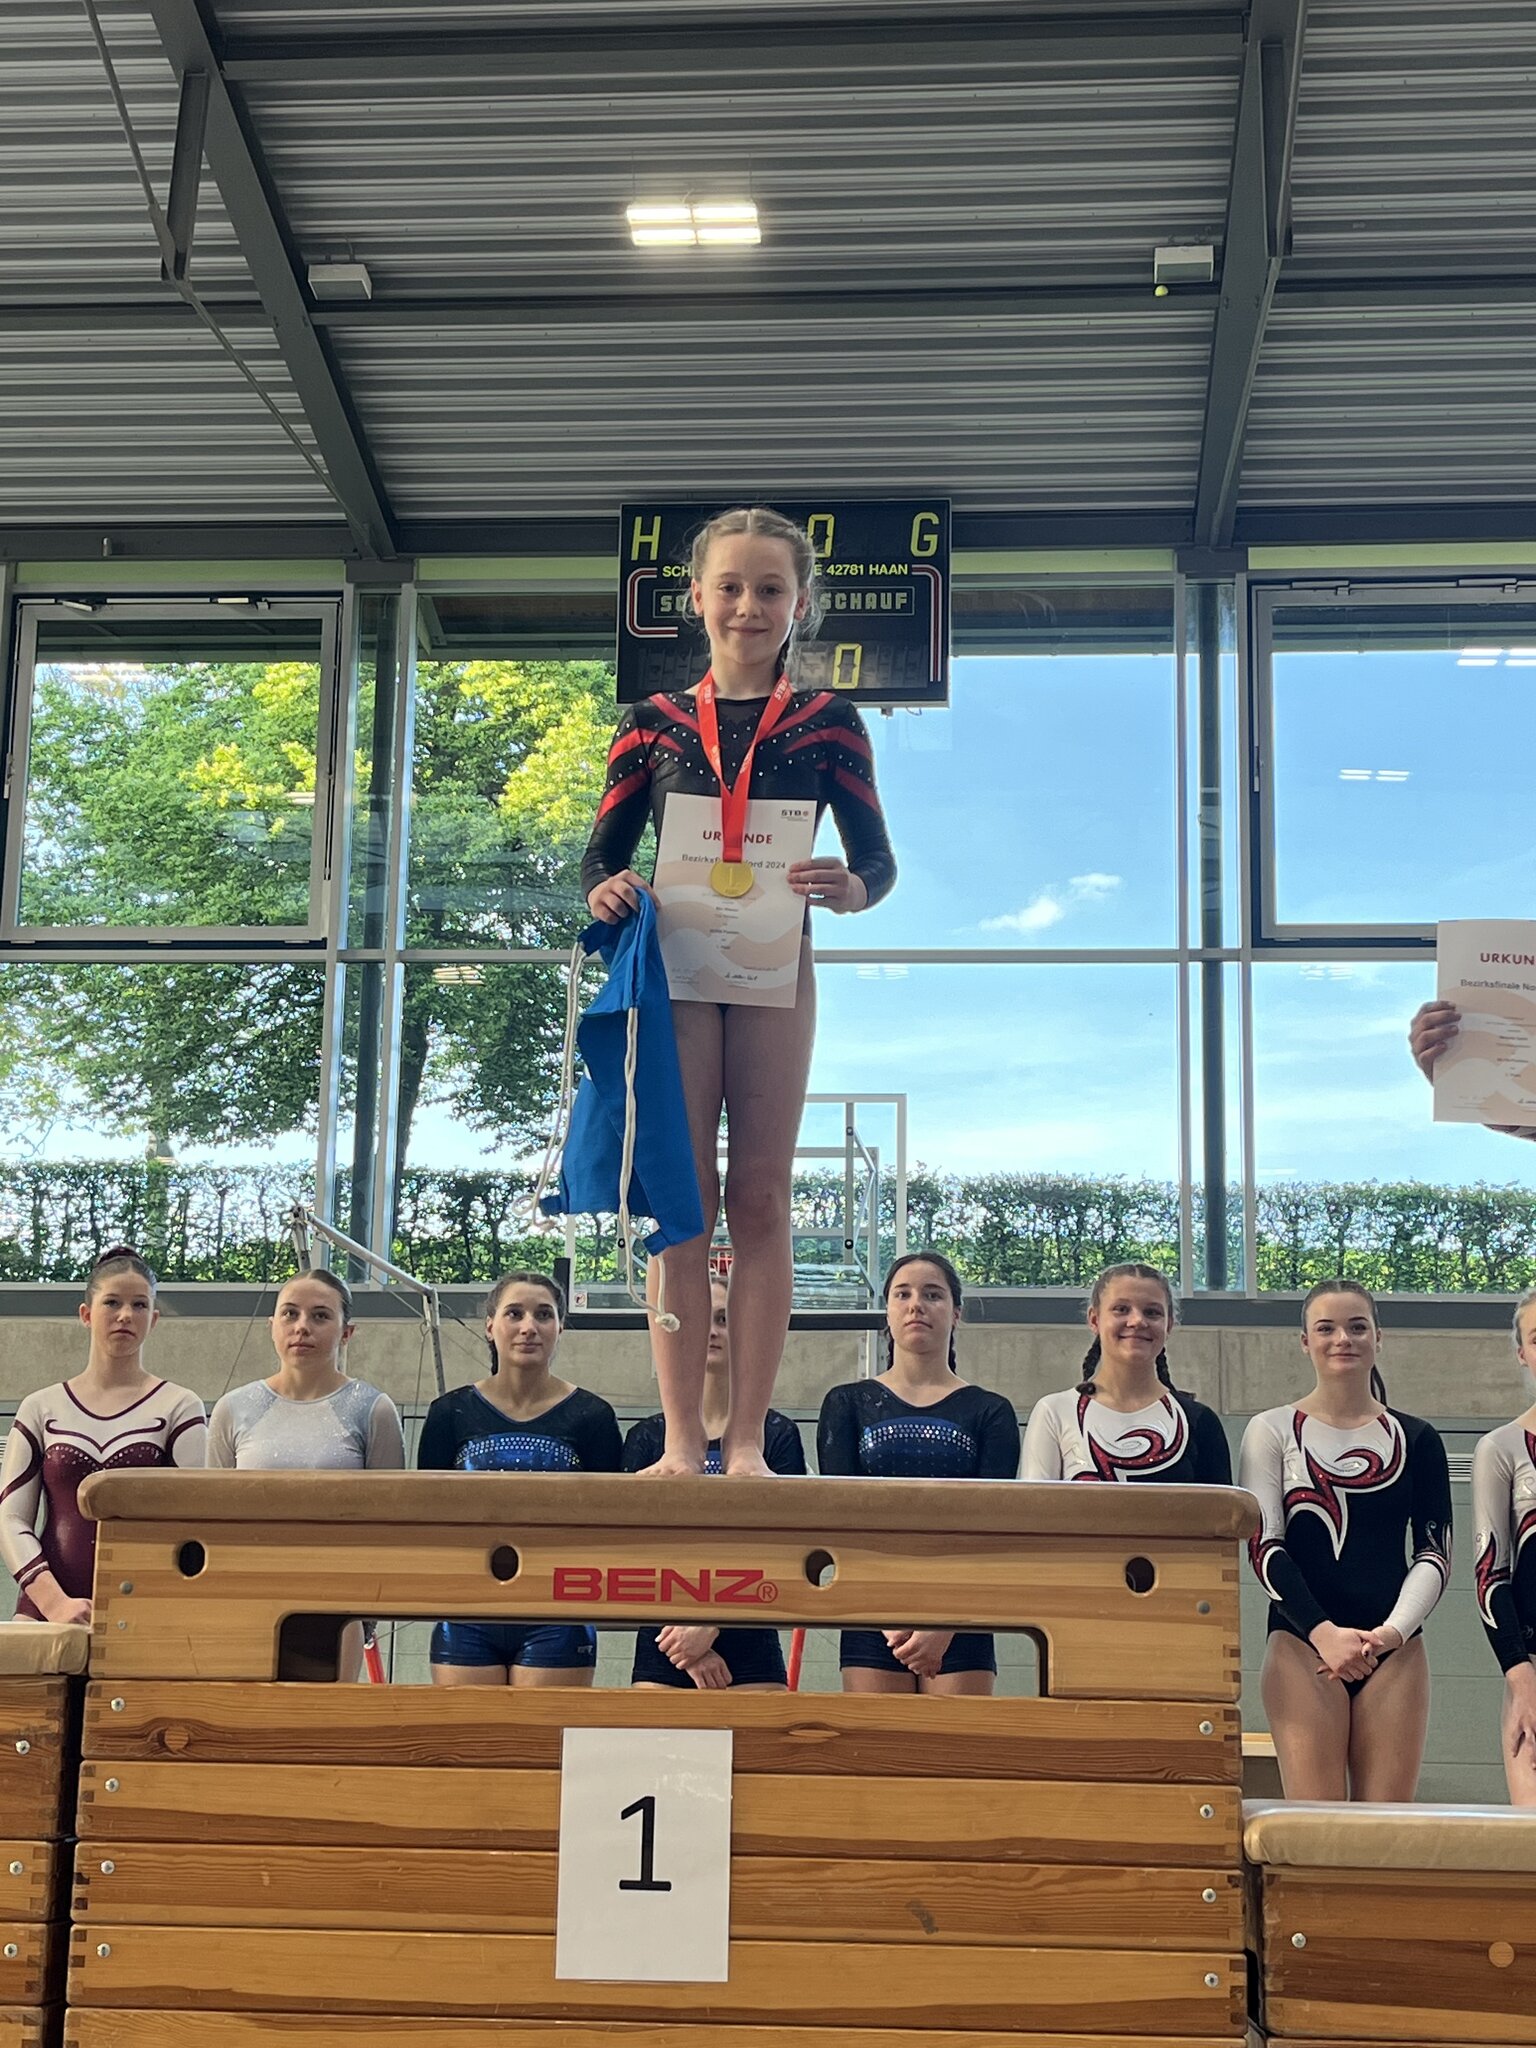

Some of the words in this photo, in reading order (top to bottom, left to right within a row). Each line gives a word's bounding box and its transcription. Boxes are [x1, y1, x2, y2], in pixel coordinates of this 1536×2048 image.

[631, 516, 662, 561] H
[807, 513, 835, 558] 0
[910, 512, 940, 557] G
[826, 564, 865, 575] 42781
[869, 564, 908, 575] HAAN
[819, 592, 908, 610] SCHAUF
[832, 643, 863, 689] 0
[702, 830, 774, 845] URNDE
[745, 860, 763, 869] ord
[1480, 952, 1535, 966] URKUN
[1460, 979, 1520, 990] Bezirksfinale
[619, 1795, 672, 1892] 1
